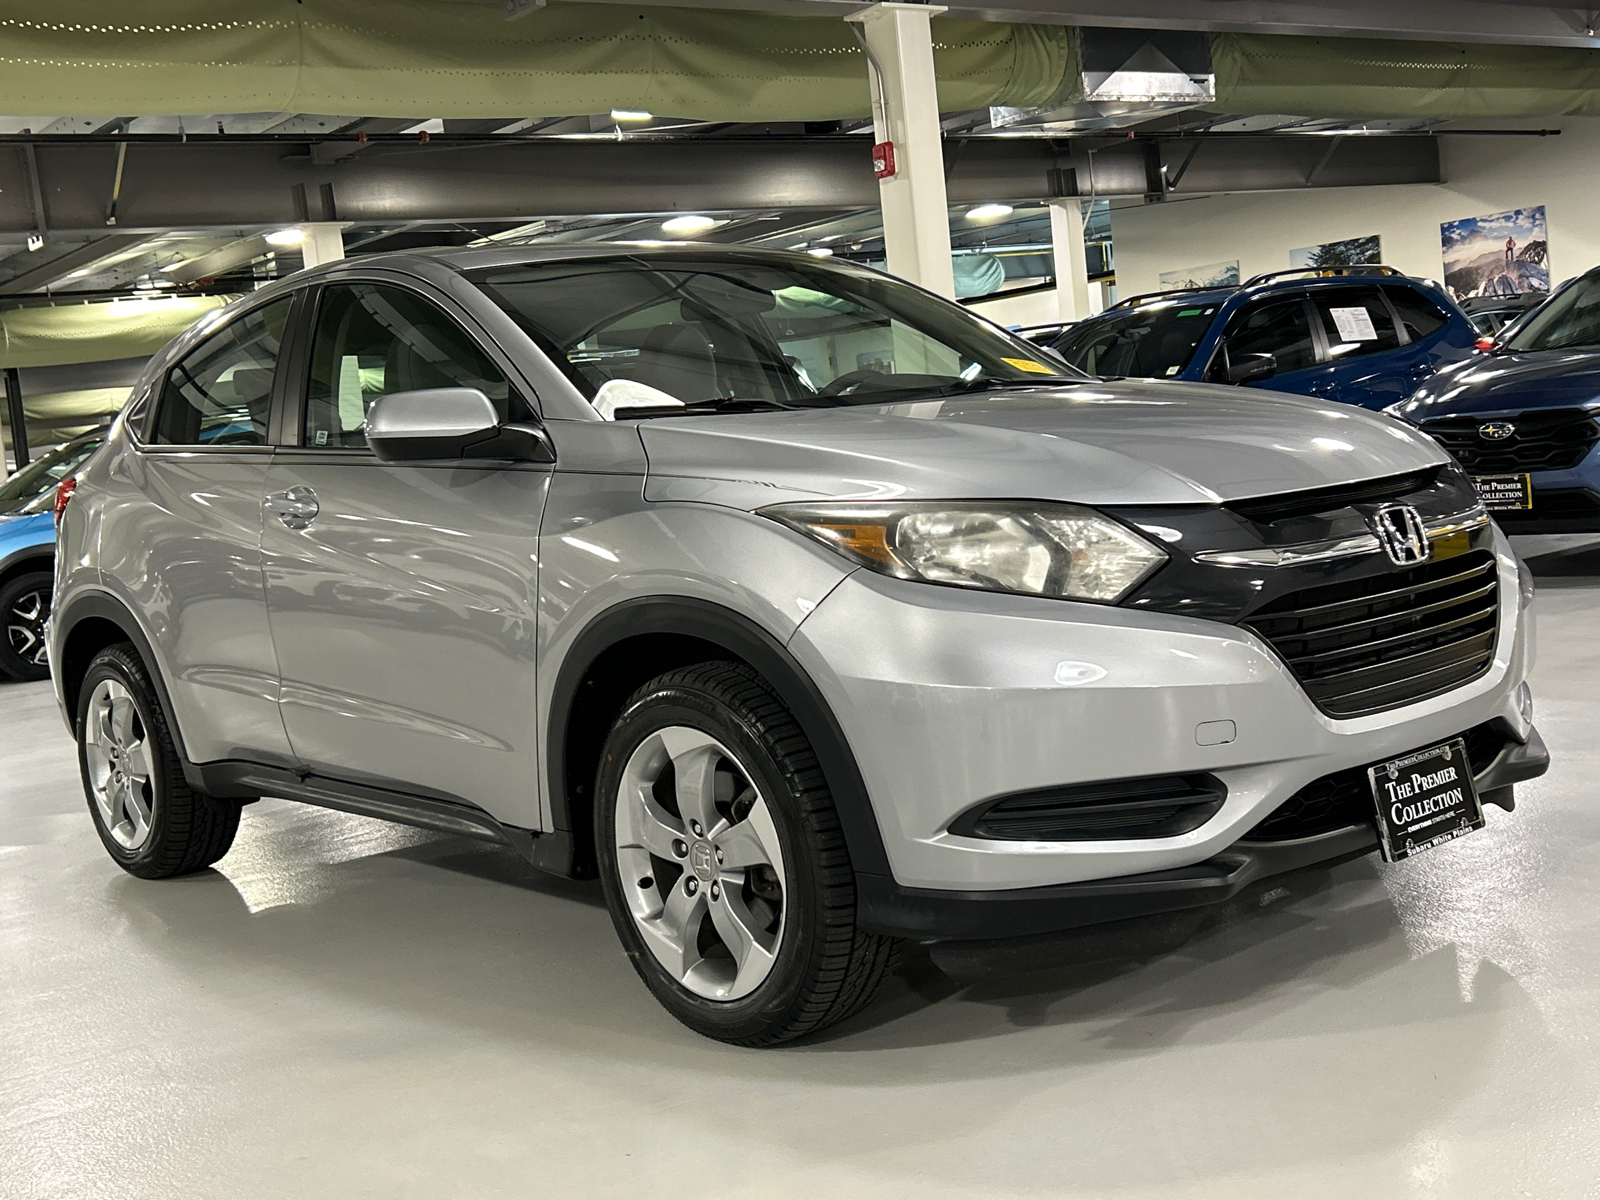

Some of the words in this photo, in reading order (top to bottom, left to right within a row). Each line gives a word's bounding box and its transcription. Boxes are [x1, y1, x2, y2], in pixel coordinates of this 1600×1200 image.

[1475, 483, 1490, 491] THE
[1491, 482, 1522, 490] PREMIER
[1385, 780, 1414, 803] THE
[1411, 766, 1459, 794] PREMIER
[1391, 787, 1464, 825] COLLECTION
[1406, 842, 1432, 857] Subaru
[1432, 833, 1452, 846] White
[1453, 825, 1474, 838] Plains
